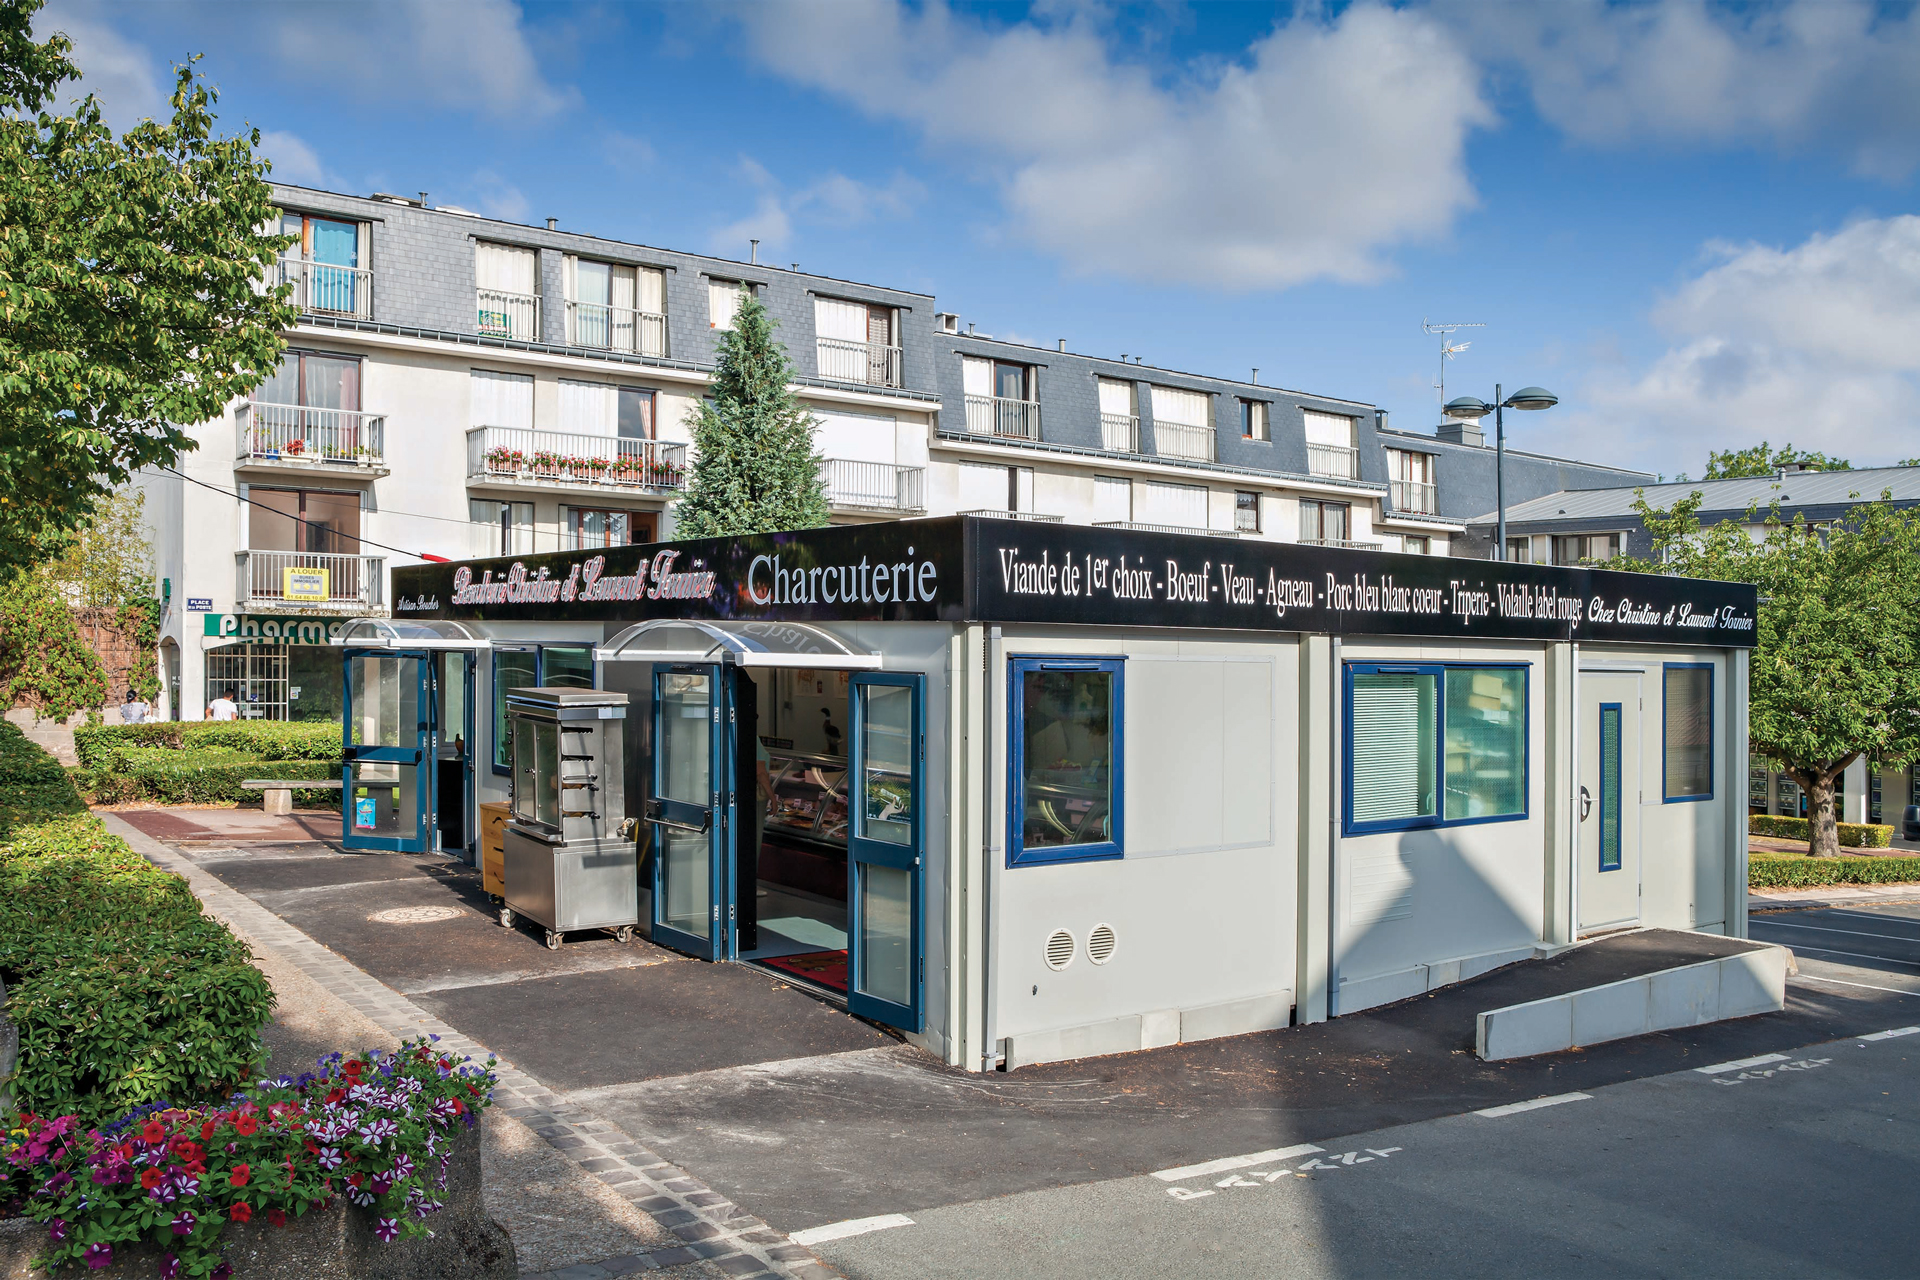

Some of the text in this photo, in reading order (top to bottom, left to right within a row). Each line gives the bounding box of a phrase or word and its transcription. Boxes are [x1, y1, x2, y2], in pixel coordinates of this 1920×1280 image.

[298, 568, 324, 576] LOUER
[506, 561, 561, 604] Christine
[560, 563, 582, 603] et
[578, 554, 650, 602] Laurent
[748, 545, 938, 605] Charcuterie
[999, 548, 1057, 595] Viande
[1061, 551, 1080, 597] de
[1112, 555, 1153, 599] choix
[1221, 564, 1255, 604] Veau
[1266, 567, 1314, 617] Agneau
[1326, 572, 1353, 611] Porc
[1354, 573, 1379, 612] bleu
[1381, 574, 1411, 613] blanc
[1450, 579, 1489, 625] Triperie
[1497, 583, 1533, 619] Volaille
[1534, 584, 1557, 620] label
[1558, 597, 1583, 630] rouge
[1588, 595, 1615, 624] Chez
[1616, 598, 1661, 626] Christine
[1662, 605, 1676, 627] et
[1676, 603, 1719, 629] Laurent
[1165, 1146, 1403, 1201] PAYANT
